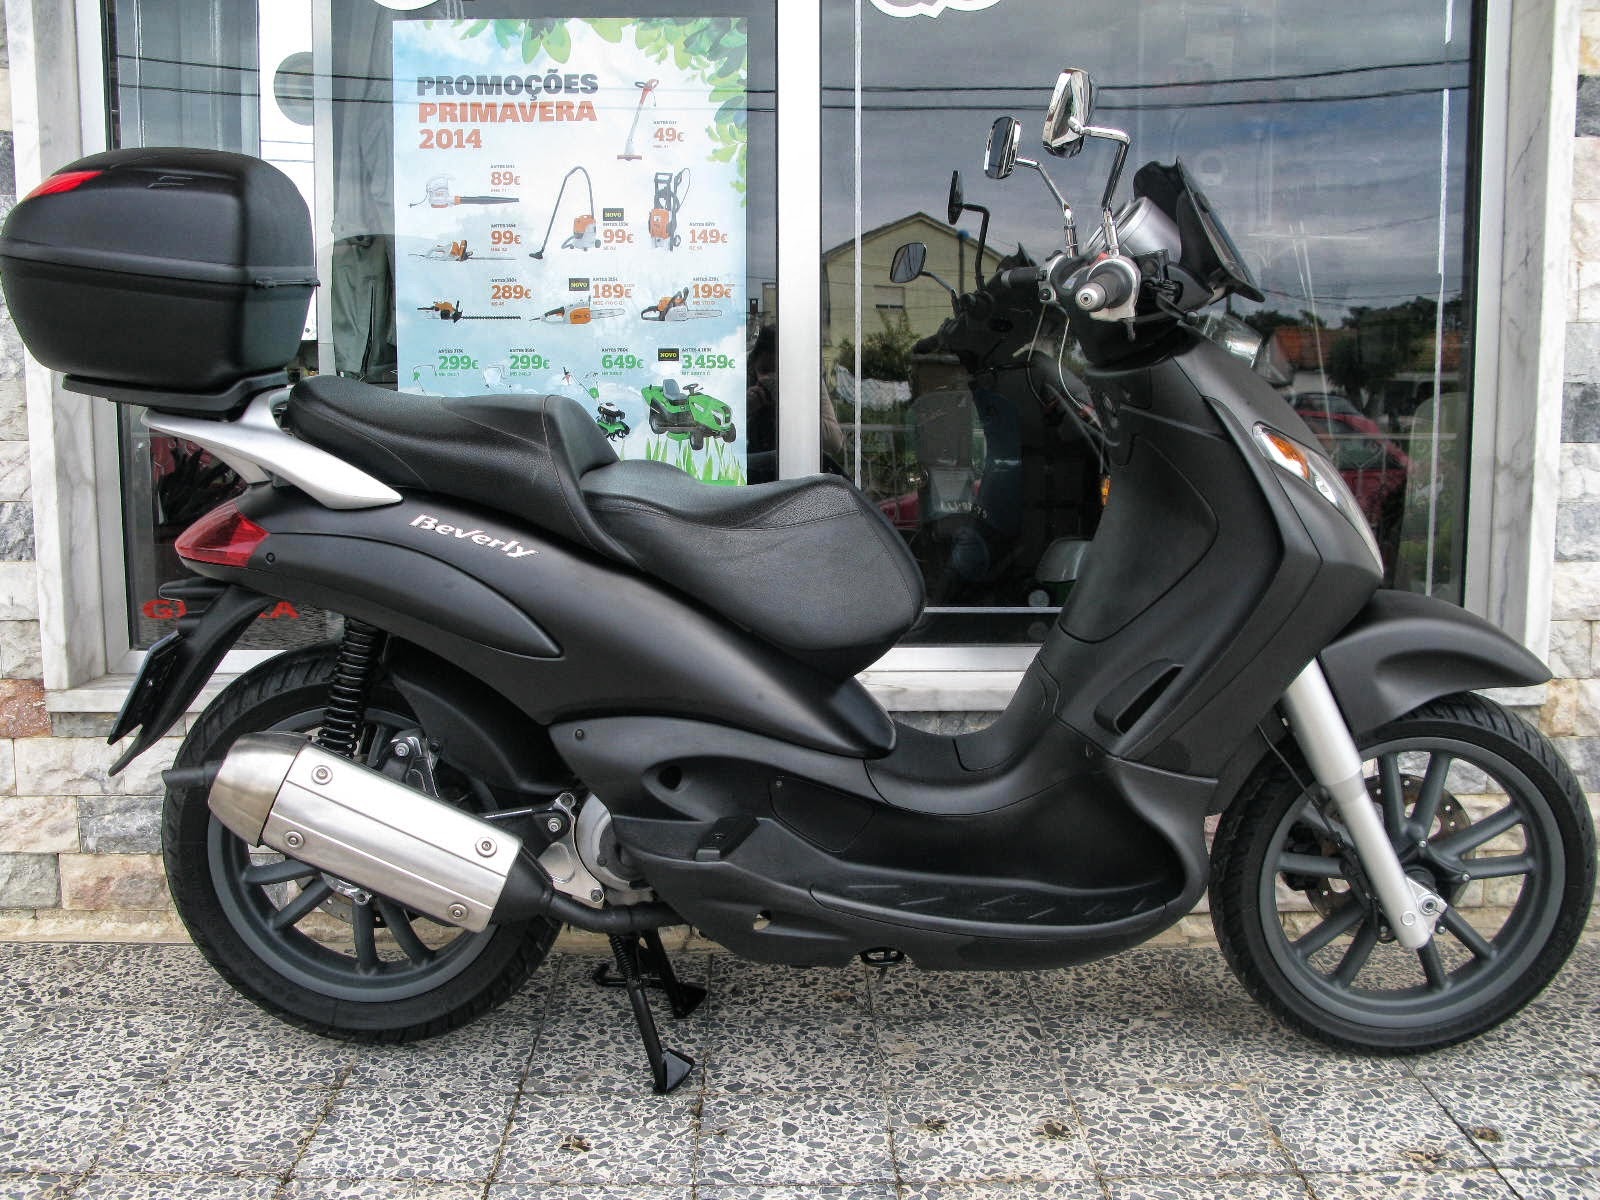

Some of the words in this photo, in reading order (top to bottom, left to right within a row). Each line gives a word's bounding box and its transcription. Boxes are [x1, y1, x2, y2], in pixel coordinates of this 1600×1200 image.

[416, 69, 599, 102] PROMOÇÕES
[418, 101, 598, 124] PRIMAVERA
[418, 129, 483, 150] 2014
[653, 127, 686, 142] 49€
[490, 171, 521, 186] 89€
[604, 211, 622, 219] NOVO
[490, 230, 521, 245] 99€
[602, 229, 634, 244] 99€
[689, 229, 728, 244] 149€
[491, 285, 532, 300] 289€
[592, 284, 632, 299] 189€
[692, 284, 732, 299] 199€
[438, 355, 479, 370] 299€
[509, 354, 550, 370] 299€
[601, 355, 644, 369] 649€
[409, 514, 539, 558] Beverly
